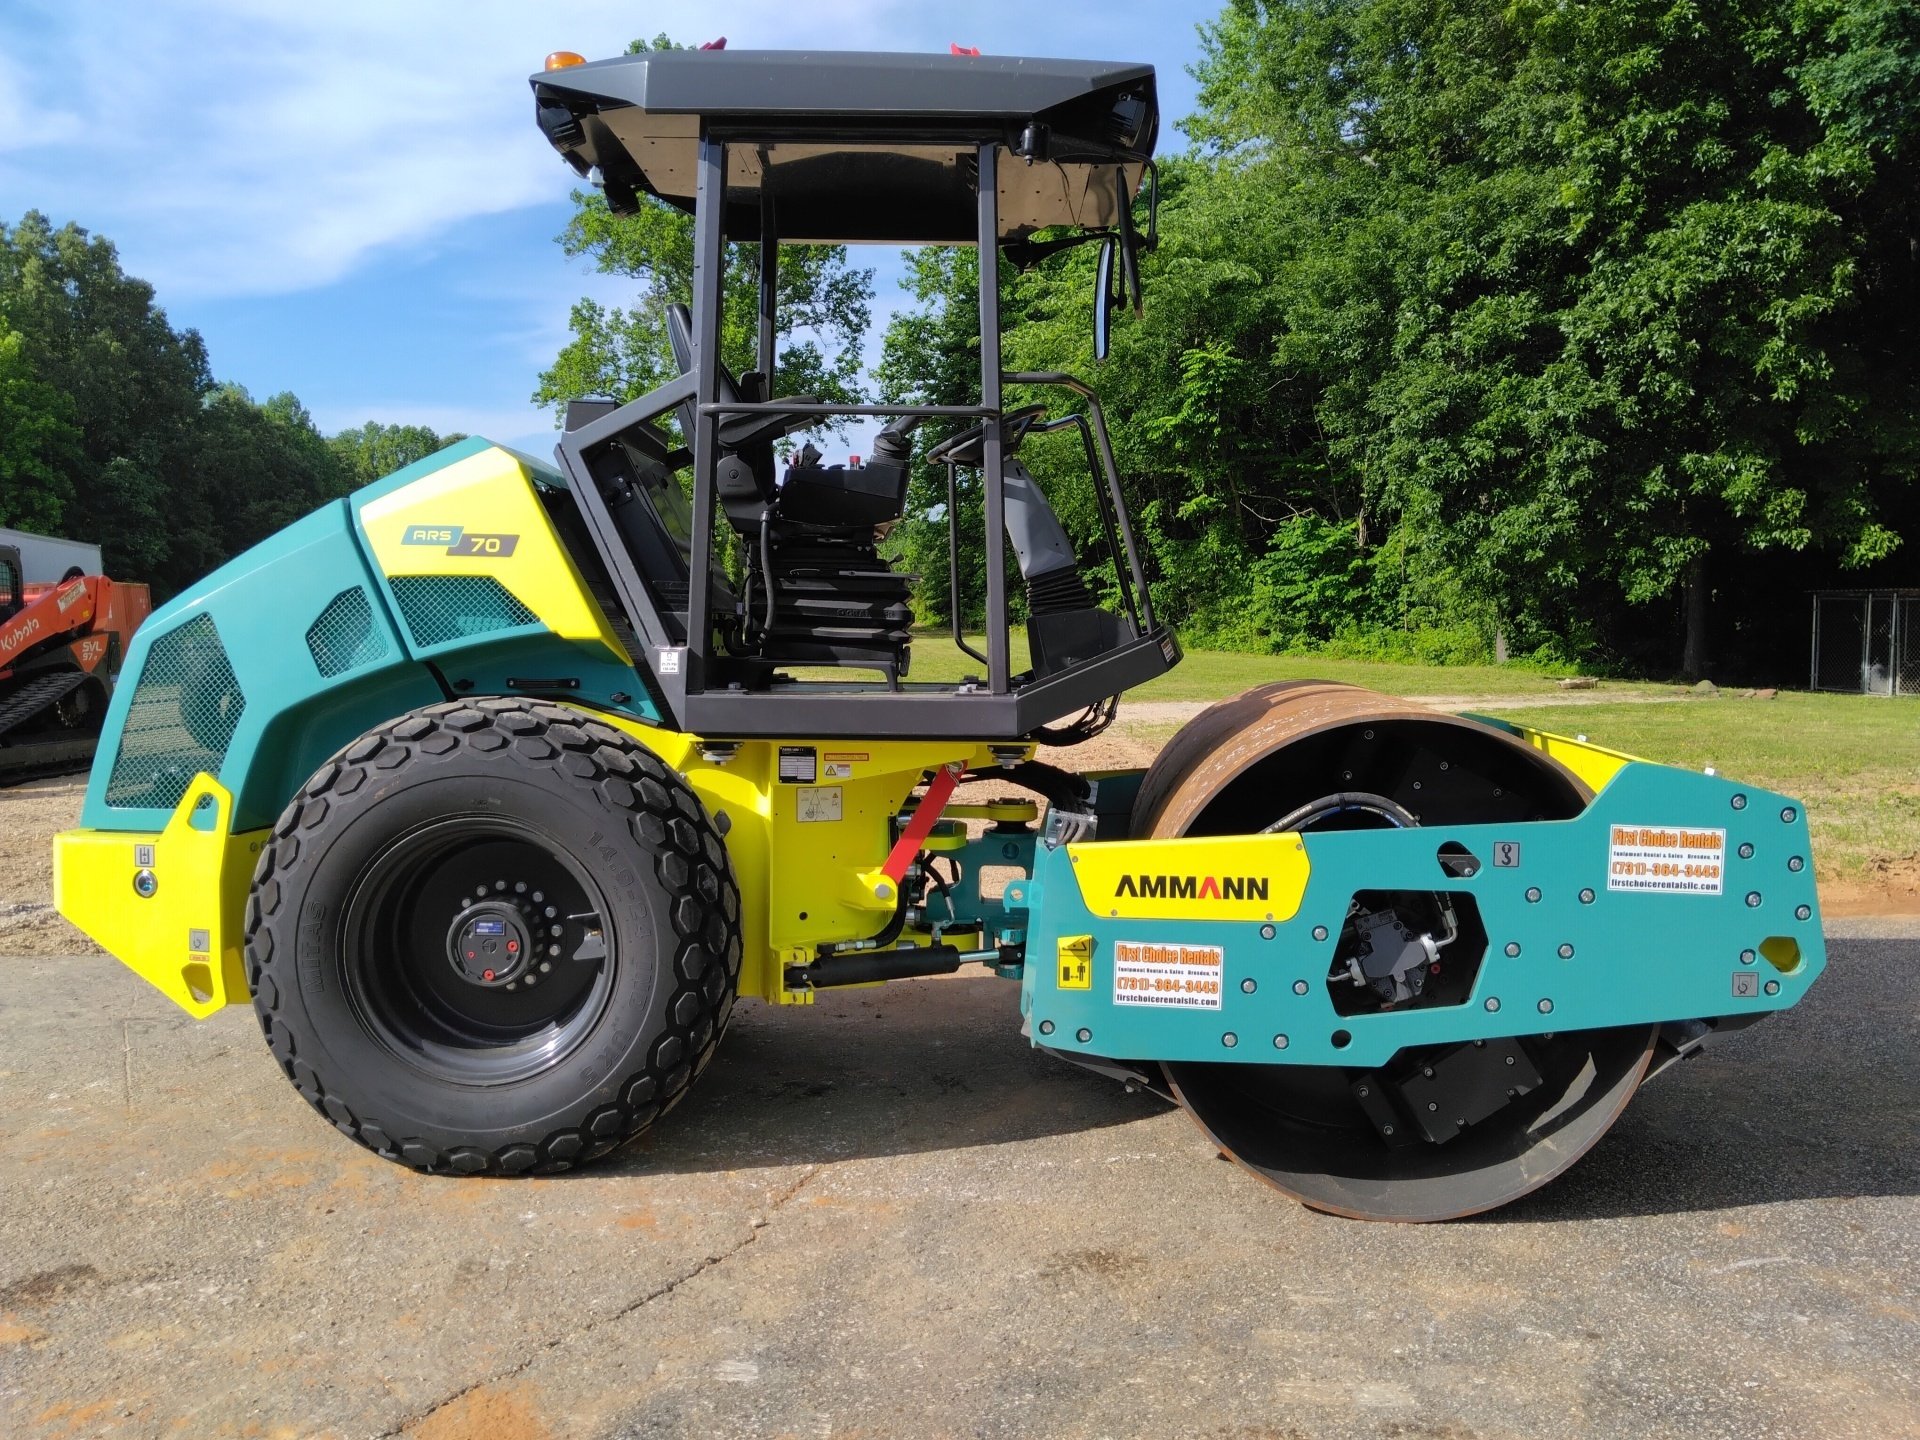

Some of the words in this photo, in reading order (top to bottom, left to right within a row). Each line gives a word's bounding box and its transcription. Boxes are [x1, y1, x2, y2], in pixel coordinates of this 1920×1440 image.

[413, 530, 452, 541] ARS
[471, 538, 500, 553] 70
[1, 618, 40, 650] Kubota
[82, 641, 103, 652] SVL
[1612, 828, 1638, 846] First
[1639, 829, 1678, 848] Choice
[1679, 831, 1722, 849] Rentals
[1612, 862, 1720, 878] (731)-364-3443
[1114, 875, 1268, 900] AMMANN
[1611, 879, 1718, 891] firstchoicerentalsllc.com
[302, 901, 328, 994] MITAS
[1117, 944, 1141, 962] First
[1142, 946, 1178, 964] Choice
[1180, 948, 1219, 966] Rentals
[1117, 977, 1218, 994] (731)-364-3443
[1117, 994, 1217, 1006] firstchoicerentalsllc.com
